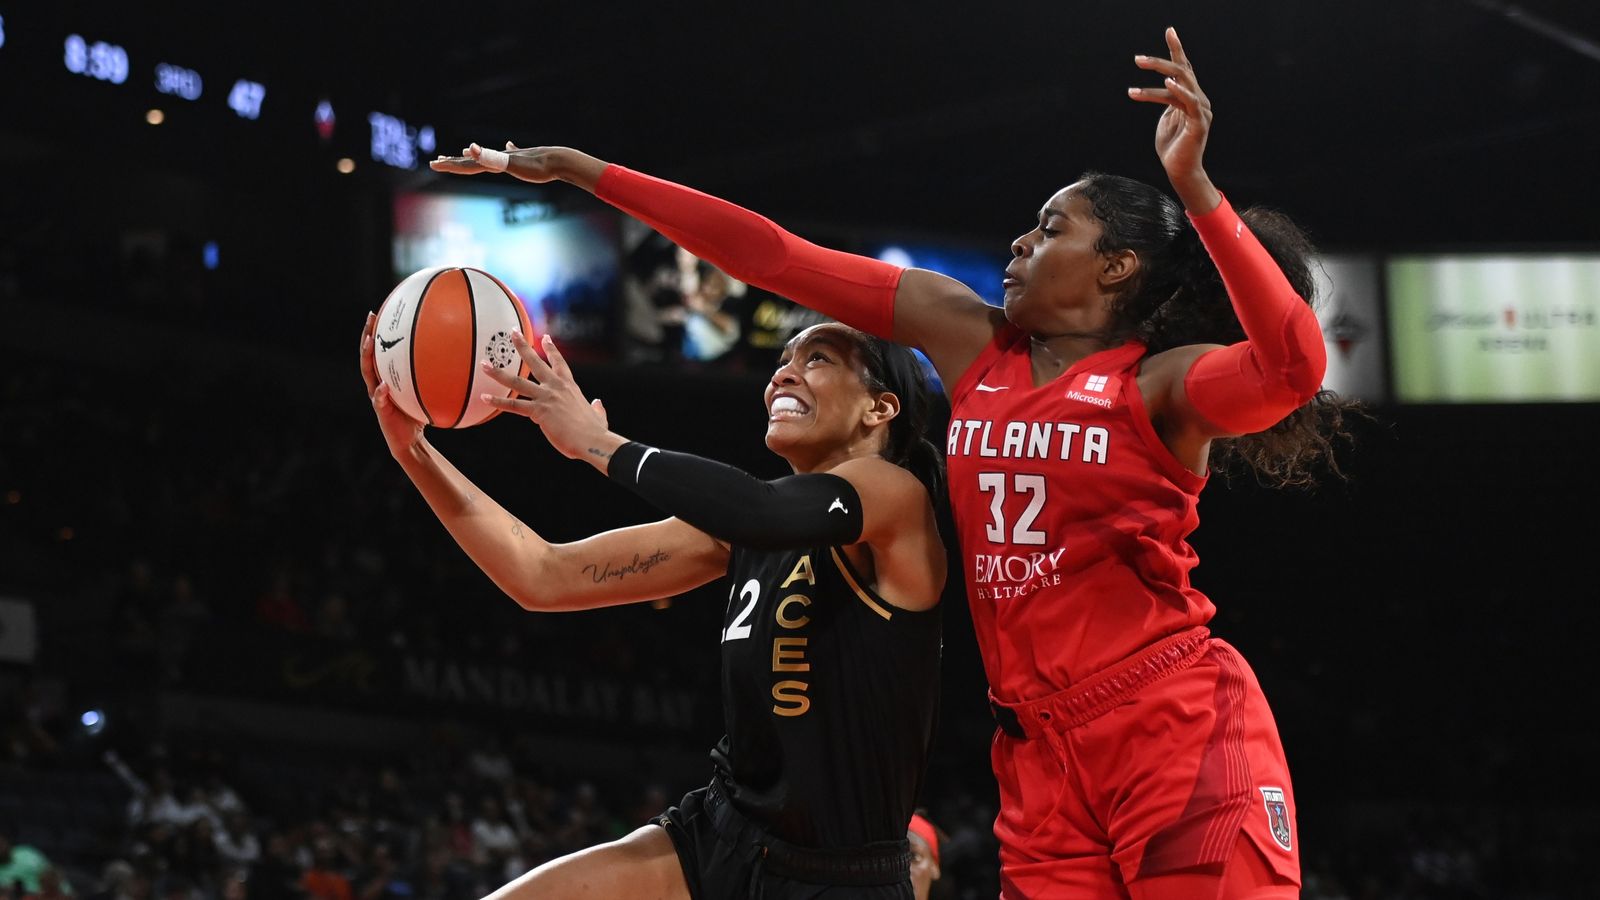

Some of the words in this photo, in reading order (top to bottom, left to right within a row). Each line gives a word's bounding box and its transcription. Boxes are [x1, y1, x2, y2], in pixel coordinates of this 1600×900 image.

[1065, 390, 1112, 409] Microsoft
[947, 419, 1109, 464] ATLANTA
[978, 473, 1047, 545] 32
[975, 547, 1066, 583] EMORY
[721, 578, 761, 644] 2
[771, 555, 816, 717] ACES
